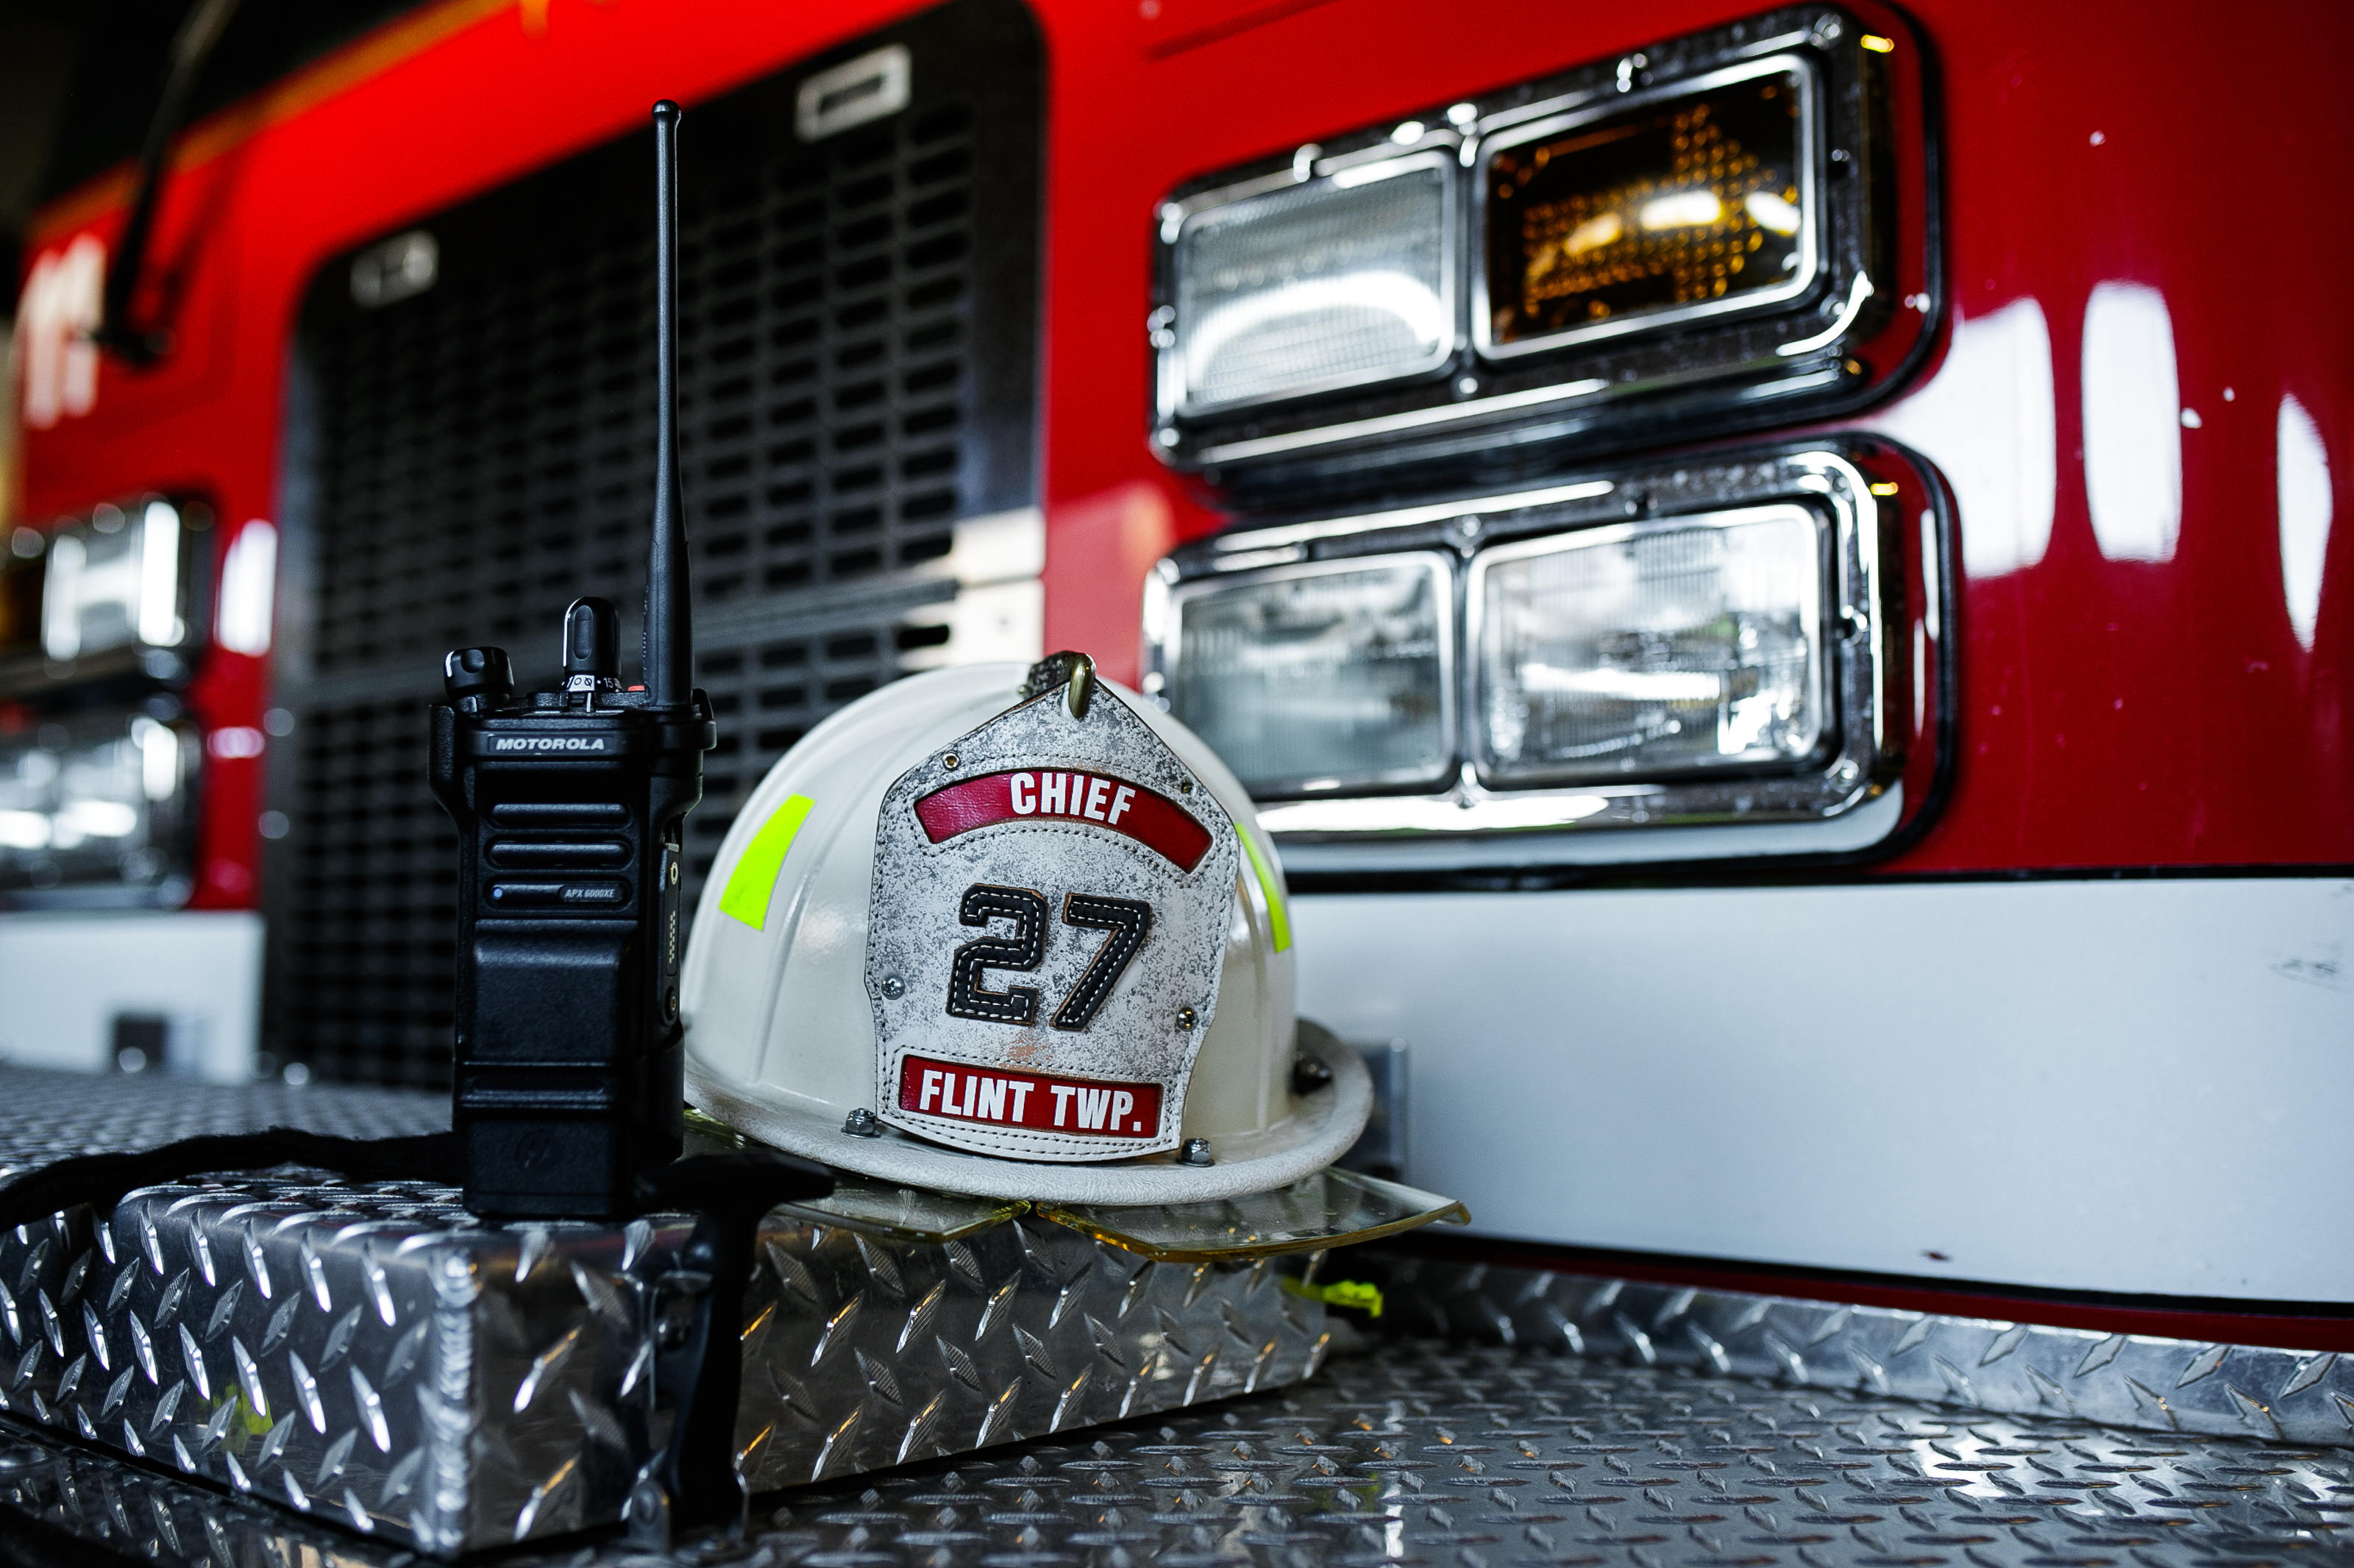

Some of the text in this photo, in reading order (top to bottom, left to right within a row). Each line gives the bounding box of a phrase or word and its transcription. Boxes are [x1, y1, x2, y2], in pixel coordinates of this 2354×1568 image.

[603, 677, 614, 688] 15
[496, 738, 605, 750] MOTOROLA
[1010, 772, 1136, 825] CHIEF
[565, 888, 616, 898] APX 6000XE
[946, 883, 1150, 1033] 27
[919, 1069, 1142, 1132] FLINT TWP.
